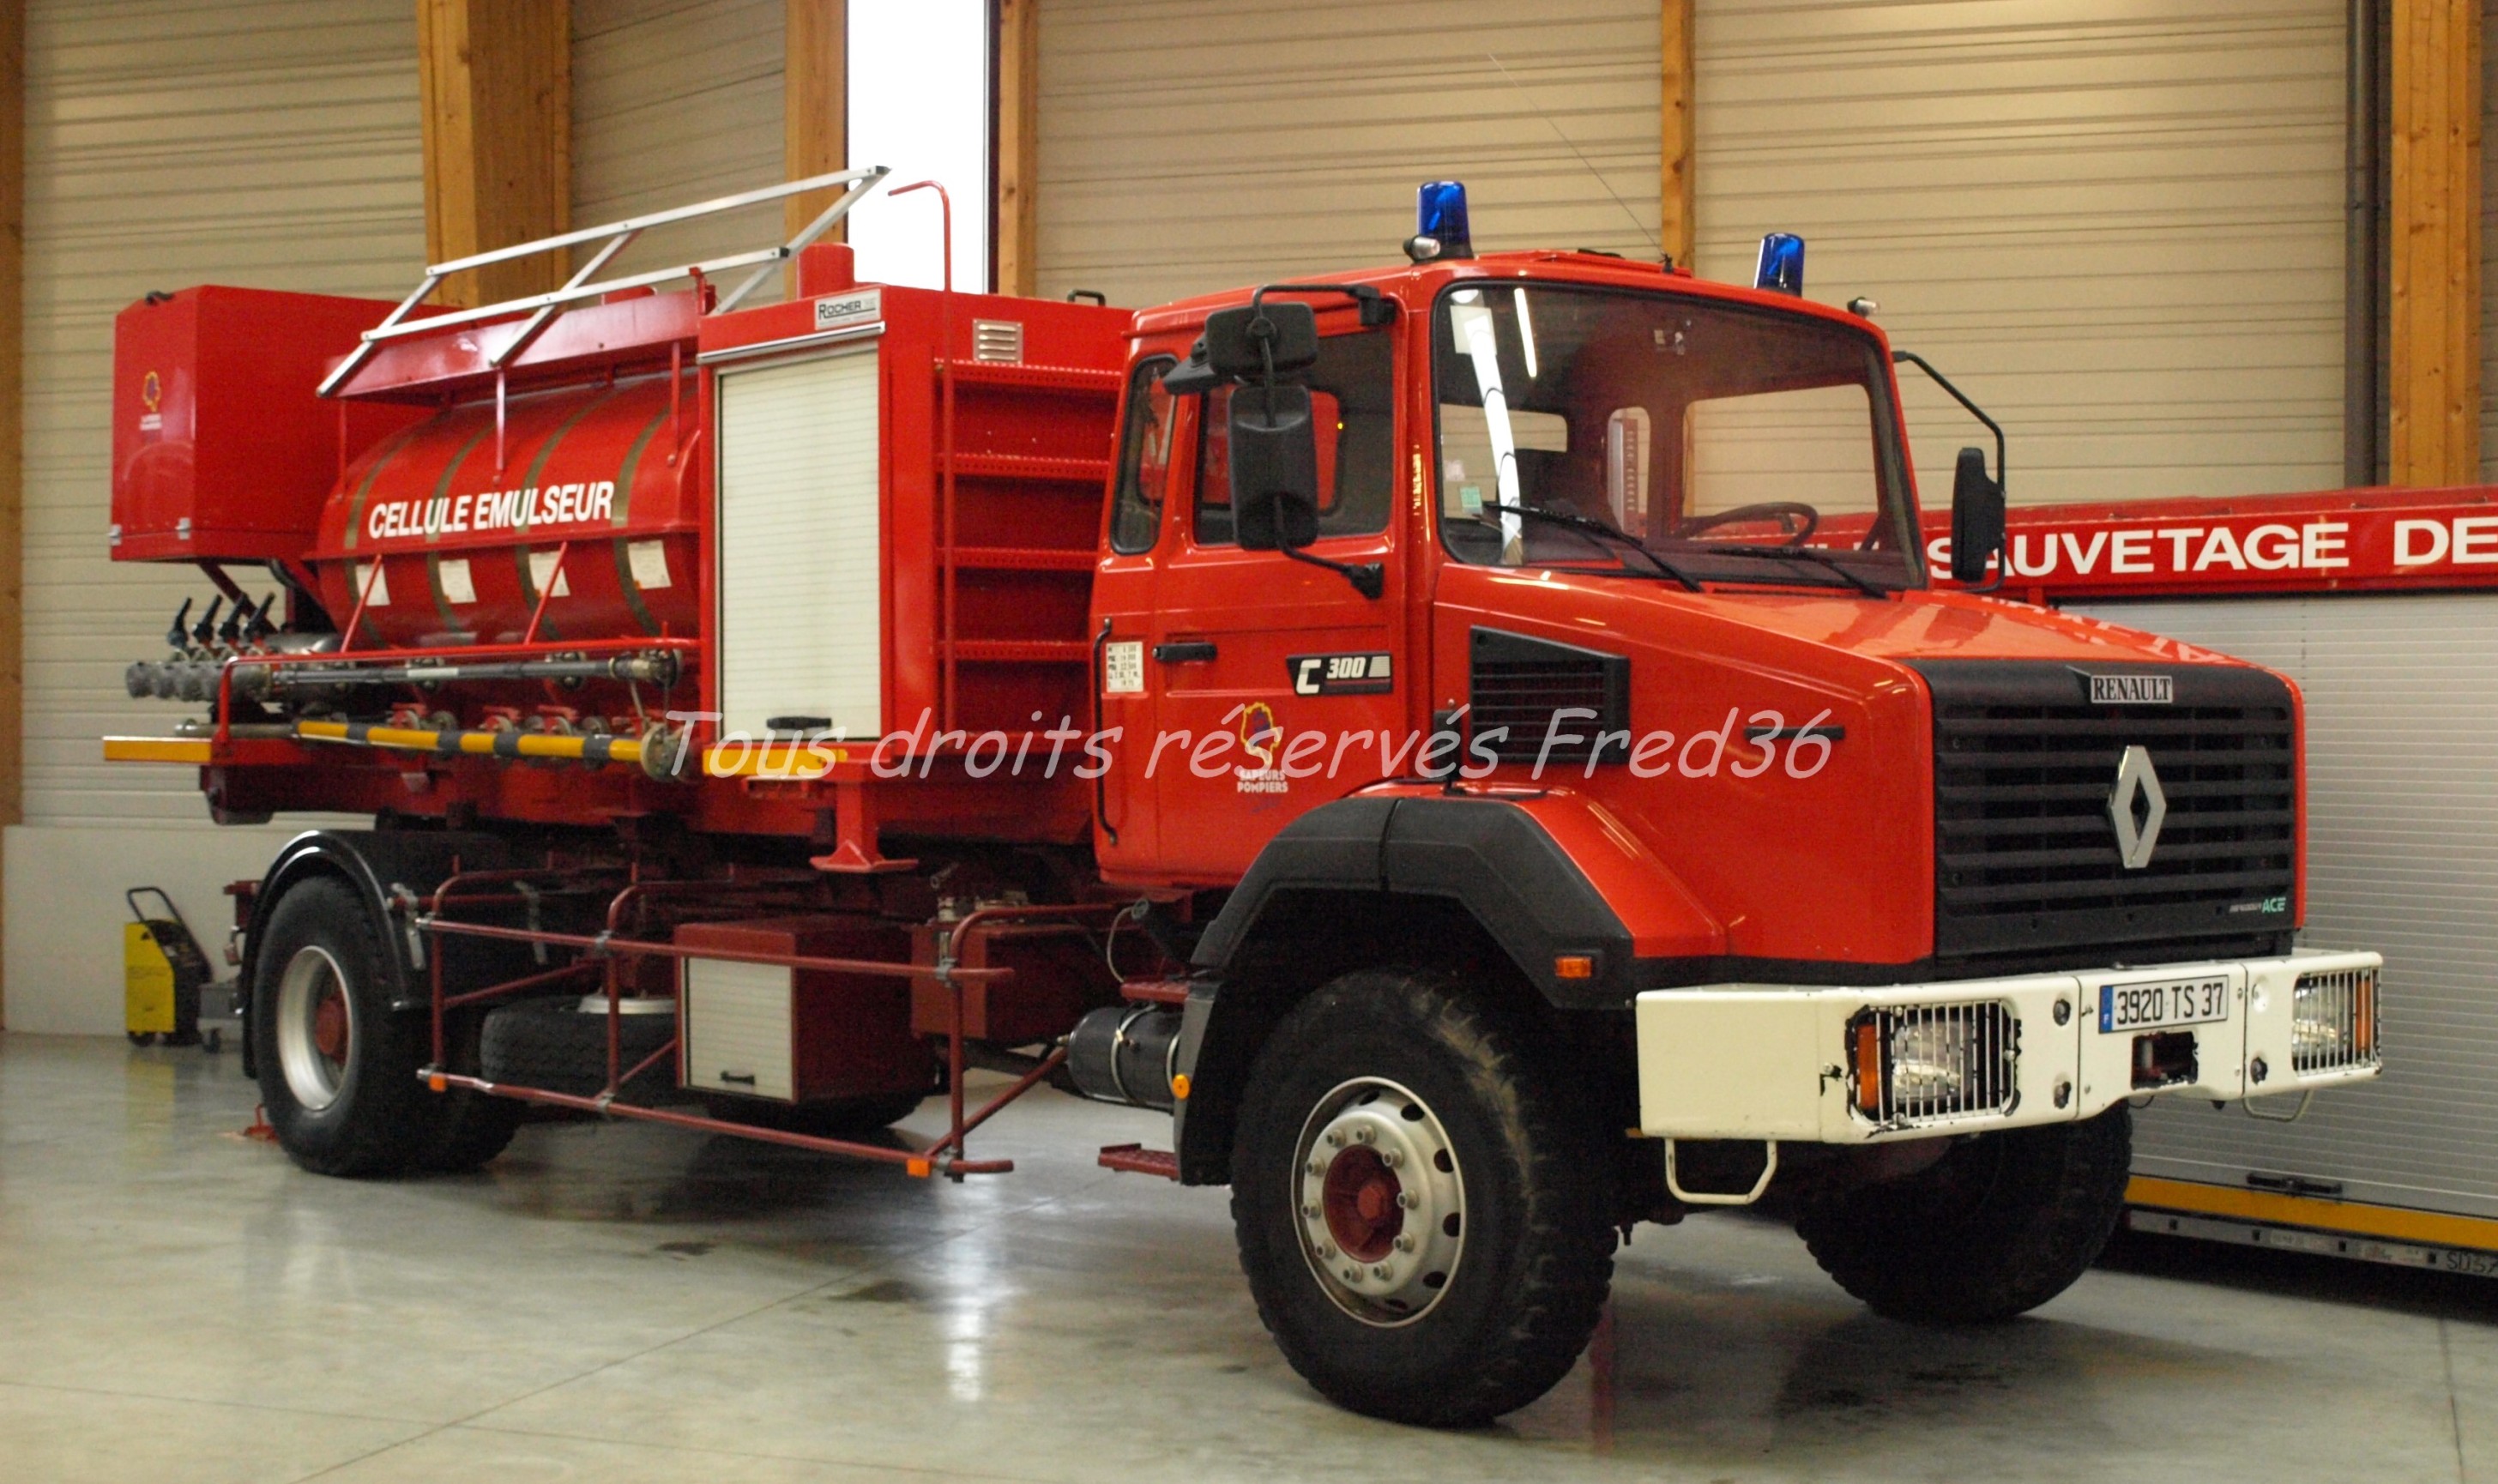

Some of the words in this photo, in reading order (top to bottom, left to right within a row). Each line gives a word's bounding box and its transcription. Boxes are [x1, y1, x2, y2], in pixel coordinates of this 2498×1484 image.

[818, 300, 861, 320] ROCHER
[368, 494, 472, 540] CELLULE
[474, 480, 615, 530] EMULSEUR
[1295, 659, 1322, 695] C
[1326, 656, 1367, 679] 300
[2093, 677, 2171, 701] RENAULT
[1239, 769, 1286, 781] SAPEURS
[1237, 781, 1288, 793] POMPIERS
[2261, 896, 2287, 914] ACE
[2116, 987, 2163, 1025] 3920
[2171, 985, 2194, 1020] TS
[2201, 982, 2224, 1016] 37
